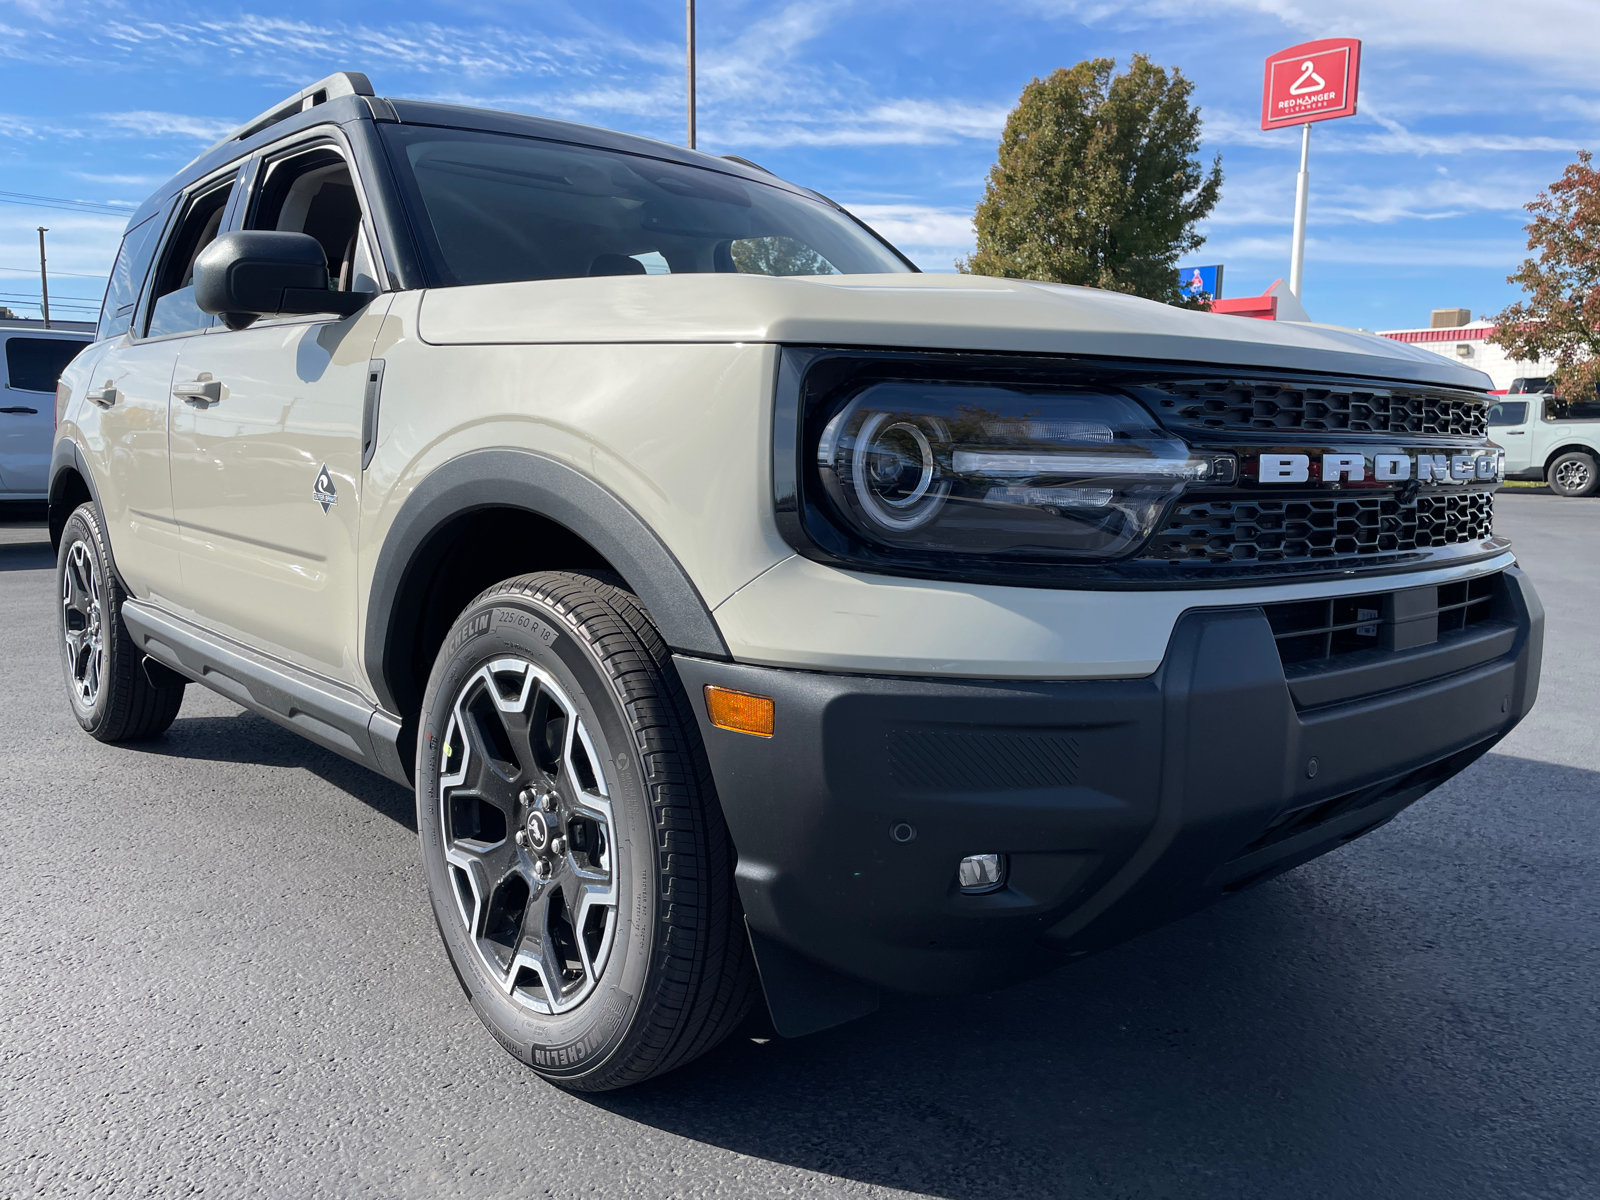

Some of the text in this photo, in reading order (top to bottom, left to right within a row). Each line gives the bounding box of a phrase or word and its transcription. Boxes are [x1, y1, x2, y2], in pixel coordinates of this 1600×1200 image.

[1285, 101, 1327, 113] CLEANERS
[1258, 453, 1496, 484] BRONCO
[440, 613, 490, 668] MICHELIN
[498, 611, 551, 641] 225/60 R 18
[487, 1023, 523, 1058] PRIMACY
[535, 1024, 604, 1066] MICHELIN
